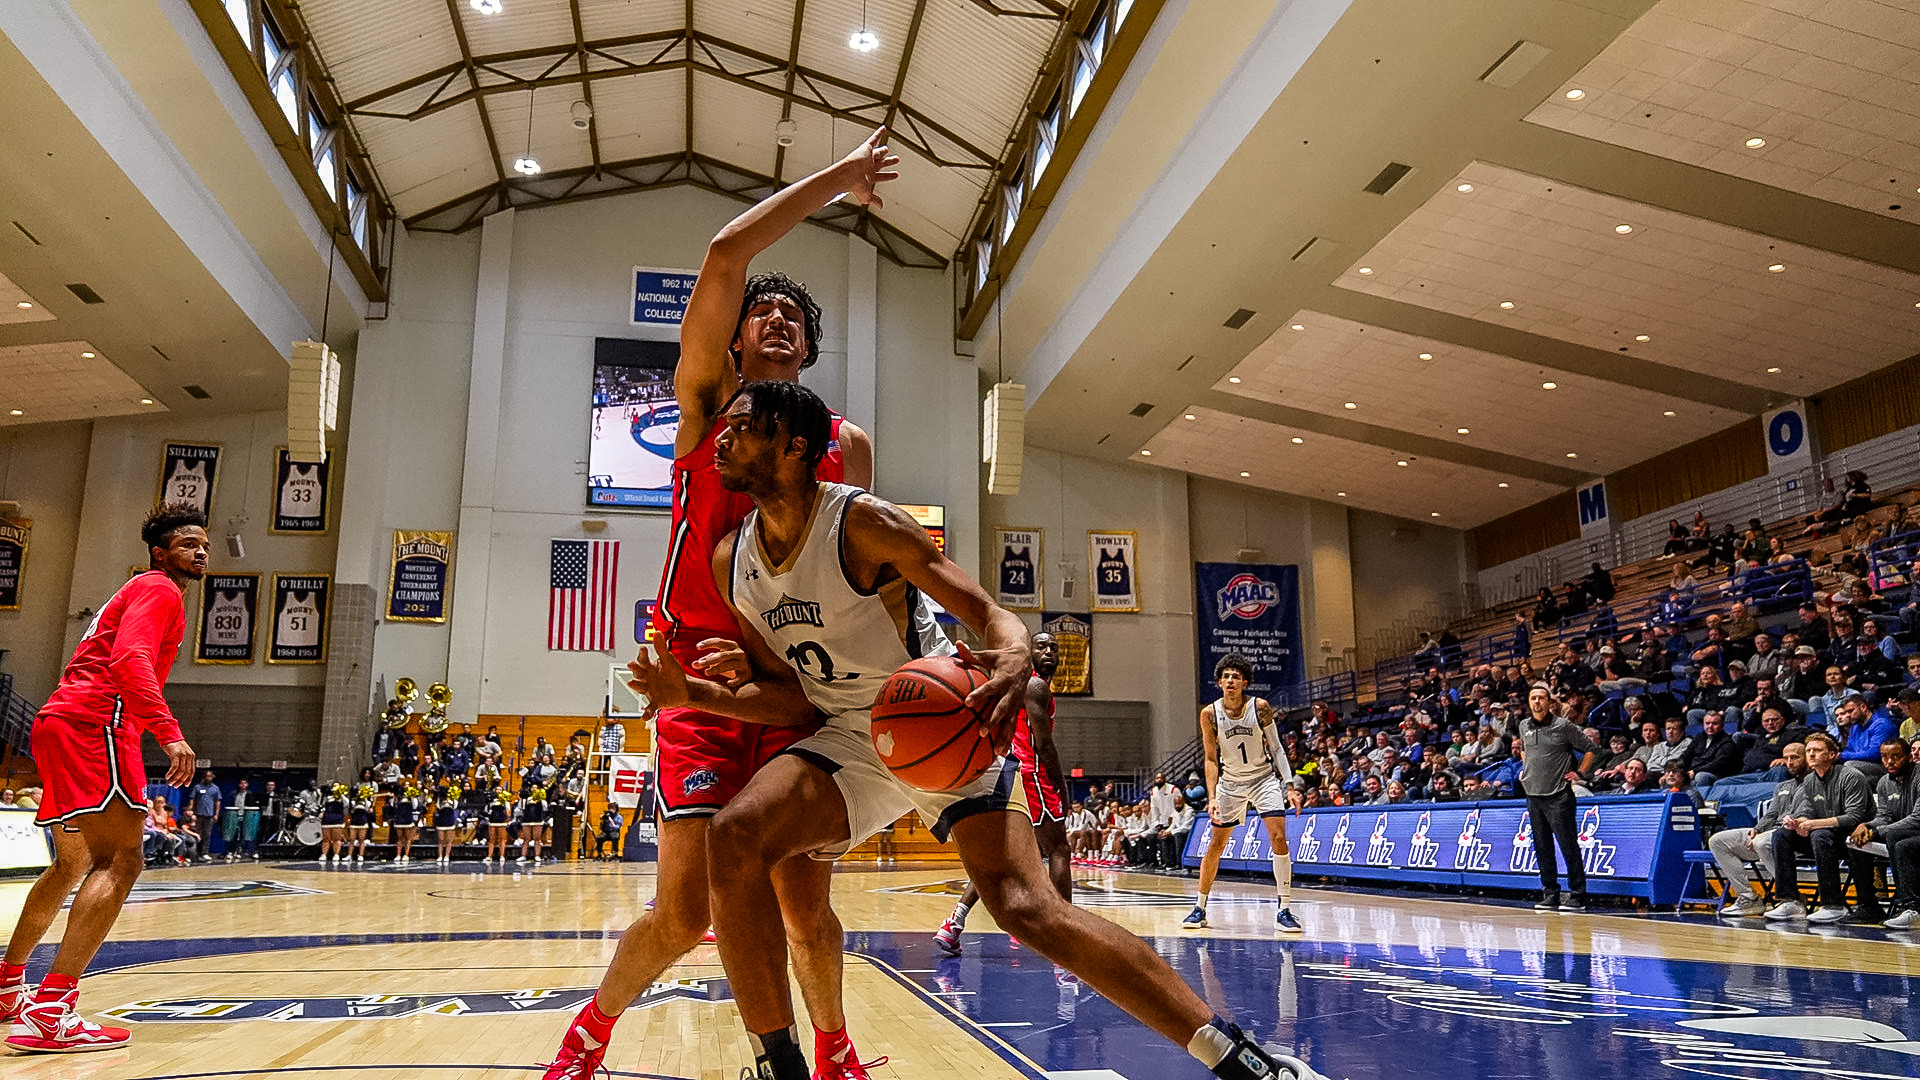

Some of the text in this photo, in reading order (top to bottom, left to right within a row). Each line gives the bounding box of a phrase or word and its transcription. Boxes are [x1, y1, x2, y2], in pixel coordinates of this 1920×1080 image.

[662, 279, 680, 289] 1962
[638, 293, 677, 304] NATIONAL
[645, 309, 682, 319] COLLEGE
[1769, 410, 1804, 456] O
[168, 447, 217, 459] SULLIVAN
[175, 475, 202, 484] MOUNT
[290, 480, 317, 488] MOUNT
[176, 484, 197, 498] 32
[292, 489, 312, 503] 33
[1578, 482, 1607, 524] M
[1003, 533, 1032, 544] BLAIR
[398, 543, 447, 559] THE MOUNT
[1009, 571, 1025, 584] 24
[1105, 570, 1121, 583] 35
[213, 578, 250, 588] PHELAN
[280, 580, 324, 589] O'REILLY
[396, 591, 440, 601] CHAMPIONS
[1219, 582, 1279, 614] MAAC
[287, 606, 314, 615] MOUNT
[404, 604, 429, 612] 2021
[214, 616, 242, 630] 830
[290, 617, 307, 631] 51
[1237, 741, 1248, 764] 1
